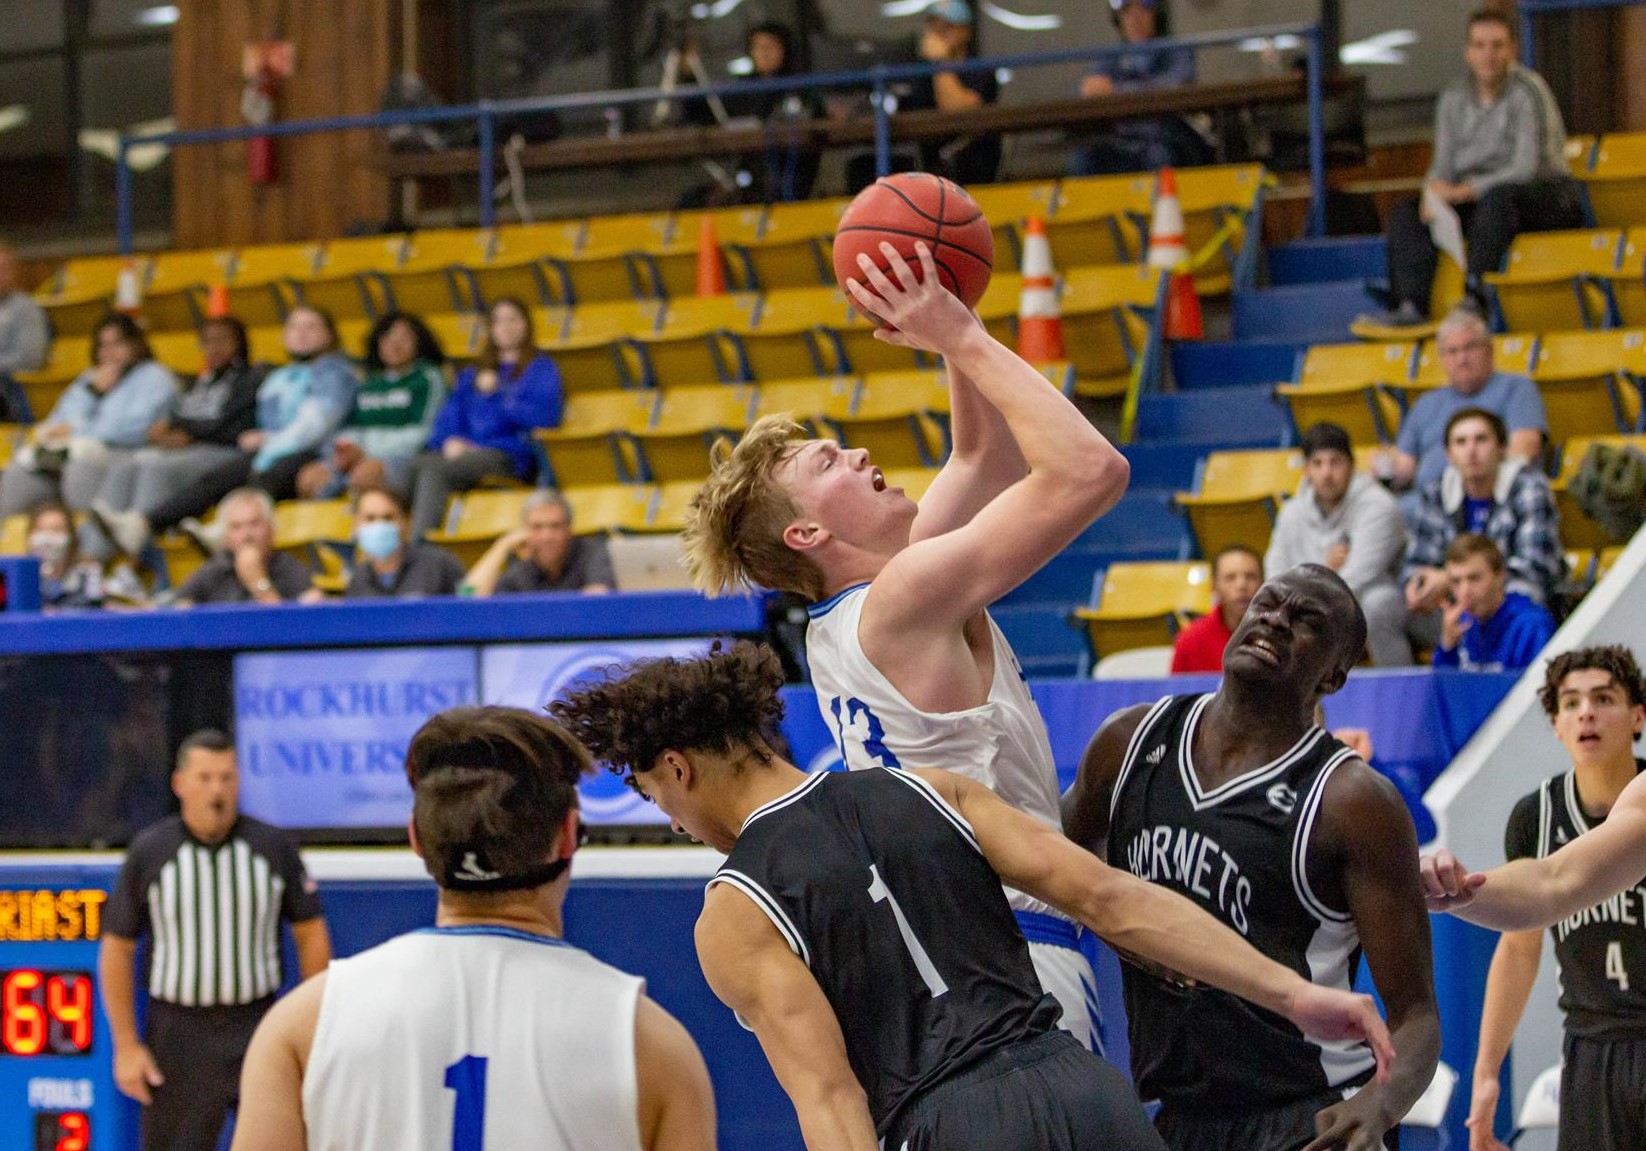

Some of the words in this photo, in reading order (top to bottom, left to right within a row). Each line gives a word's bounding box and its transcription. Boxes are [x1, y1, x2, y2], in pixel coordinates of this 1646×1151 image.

[236, 679, 474, 717] ROCKHURST
[1127, 825, 1251, 936] HORNETS
[866, 864, 949, 999] 1
[1605, 941, 1629, 991] 4
[2, 968, 93, 1056] 64
[443, 1054, 488, 1151] 1
